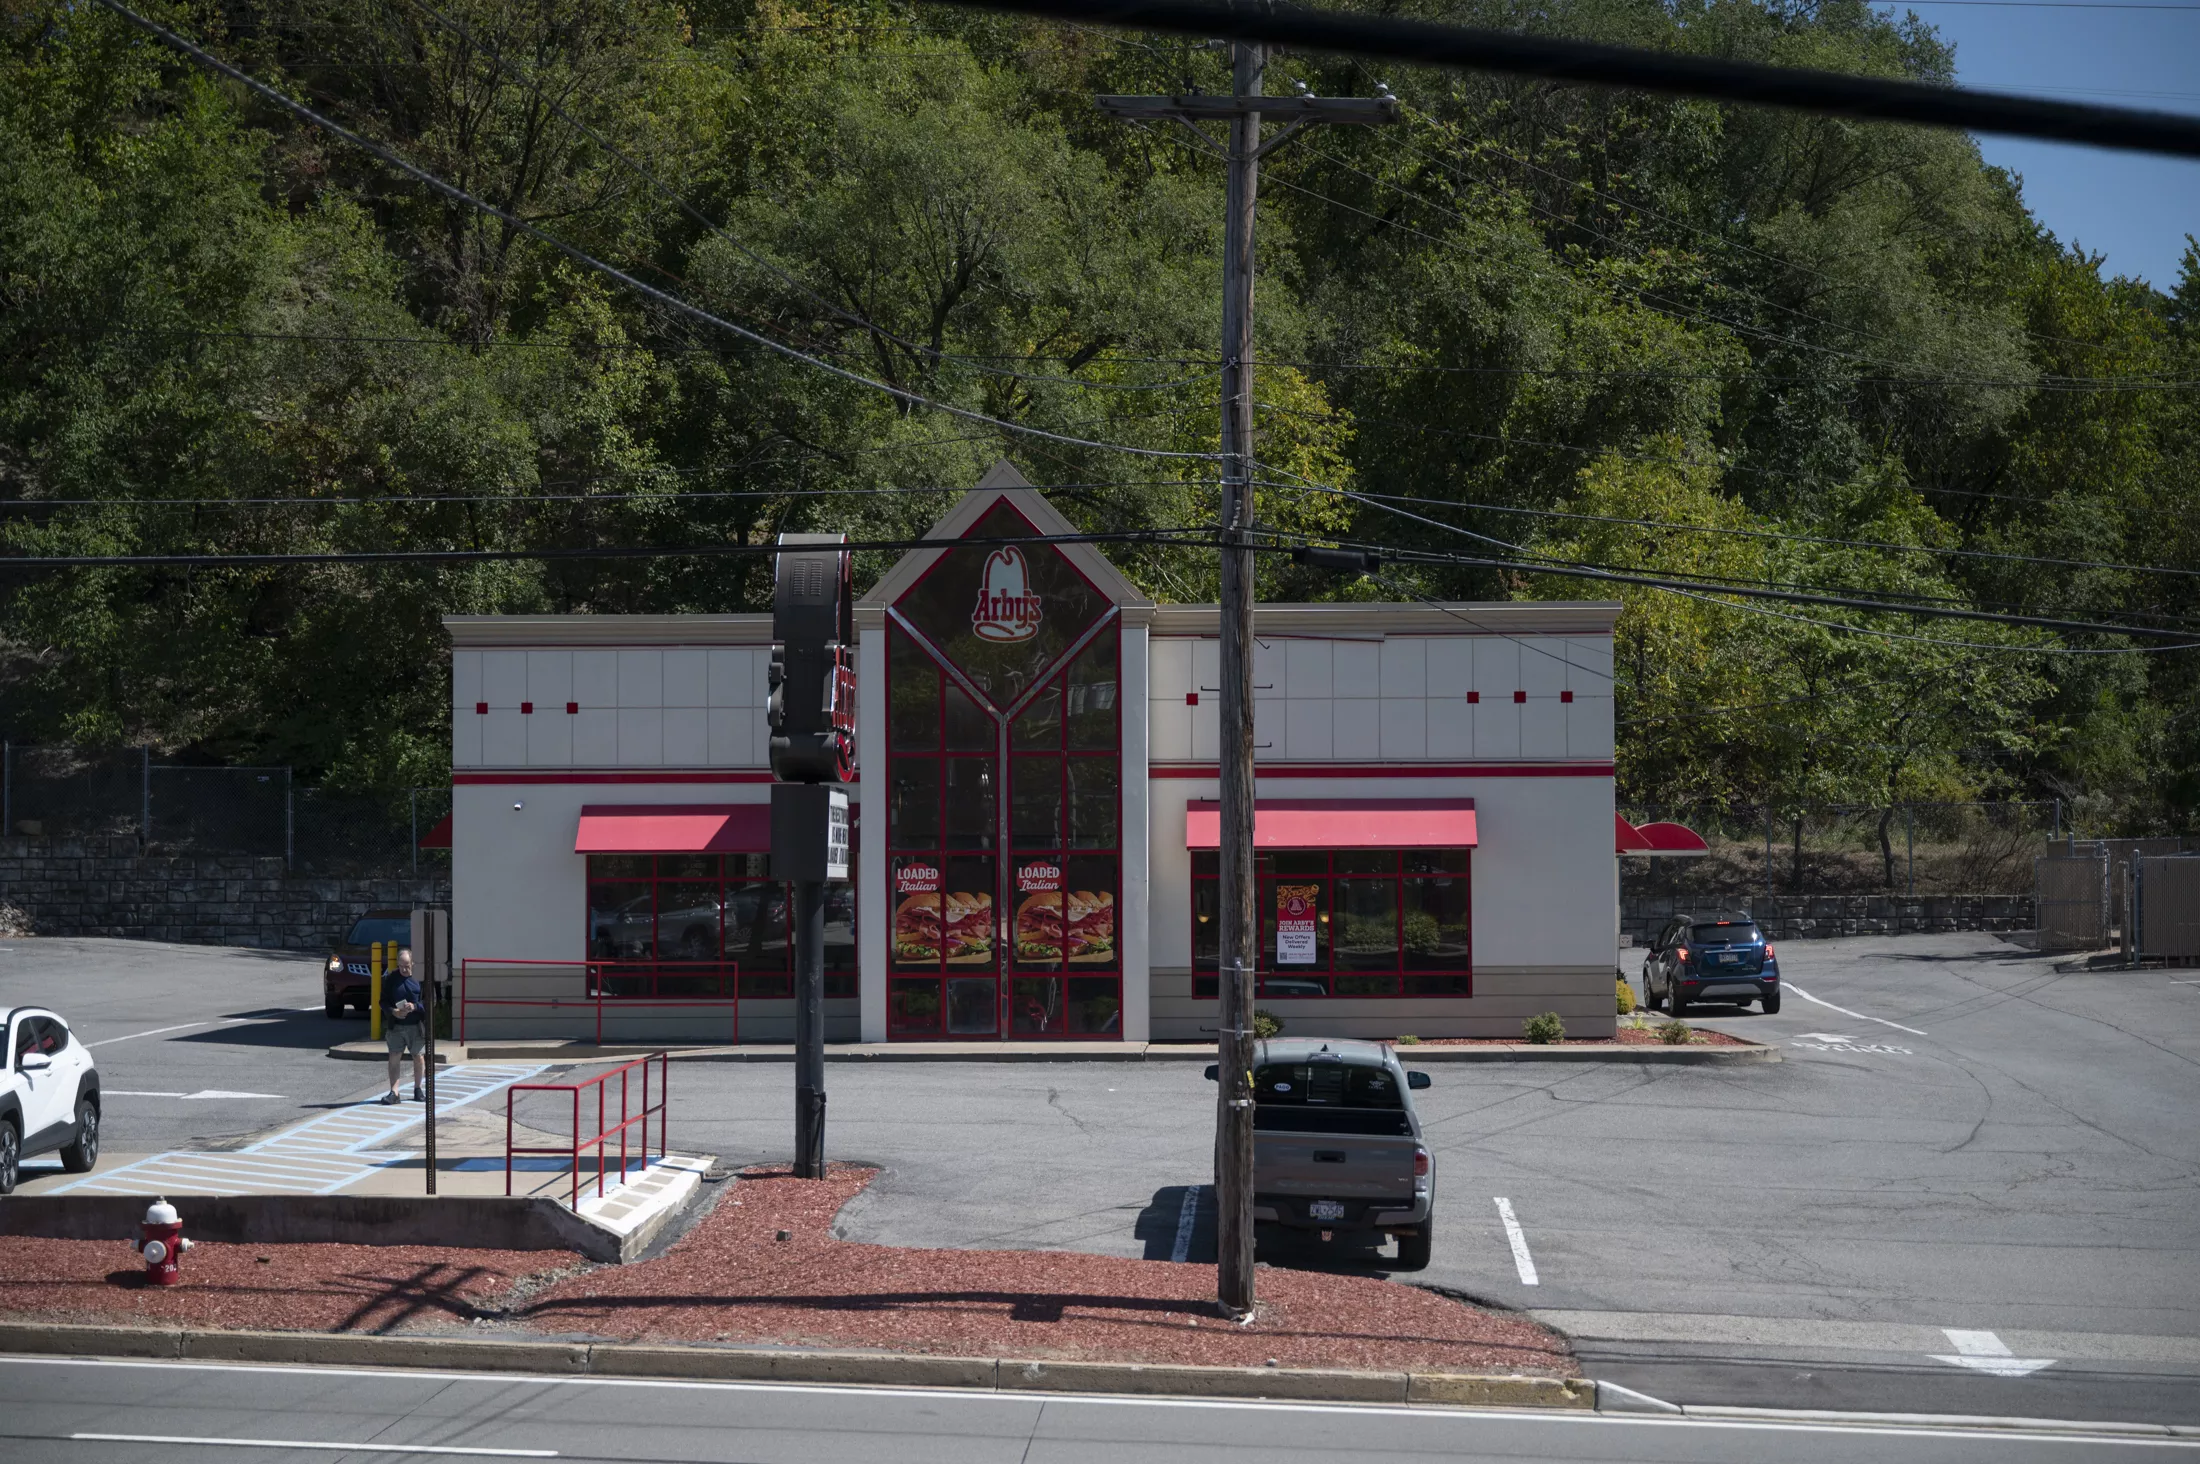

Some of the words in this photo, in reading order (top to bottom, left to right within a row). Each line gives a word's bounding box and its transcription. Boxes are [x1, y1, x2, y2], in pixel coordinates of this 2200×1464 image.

[973, 588, 1042, 629] Arby's
[897, 868, 939, 880] LOADED
[1018, 866, 1060, 879] LOADED
[897, 880, 938, 893] Italian
[1019, 879, 1060, 892] Italian
